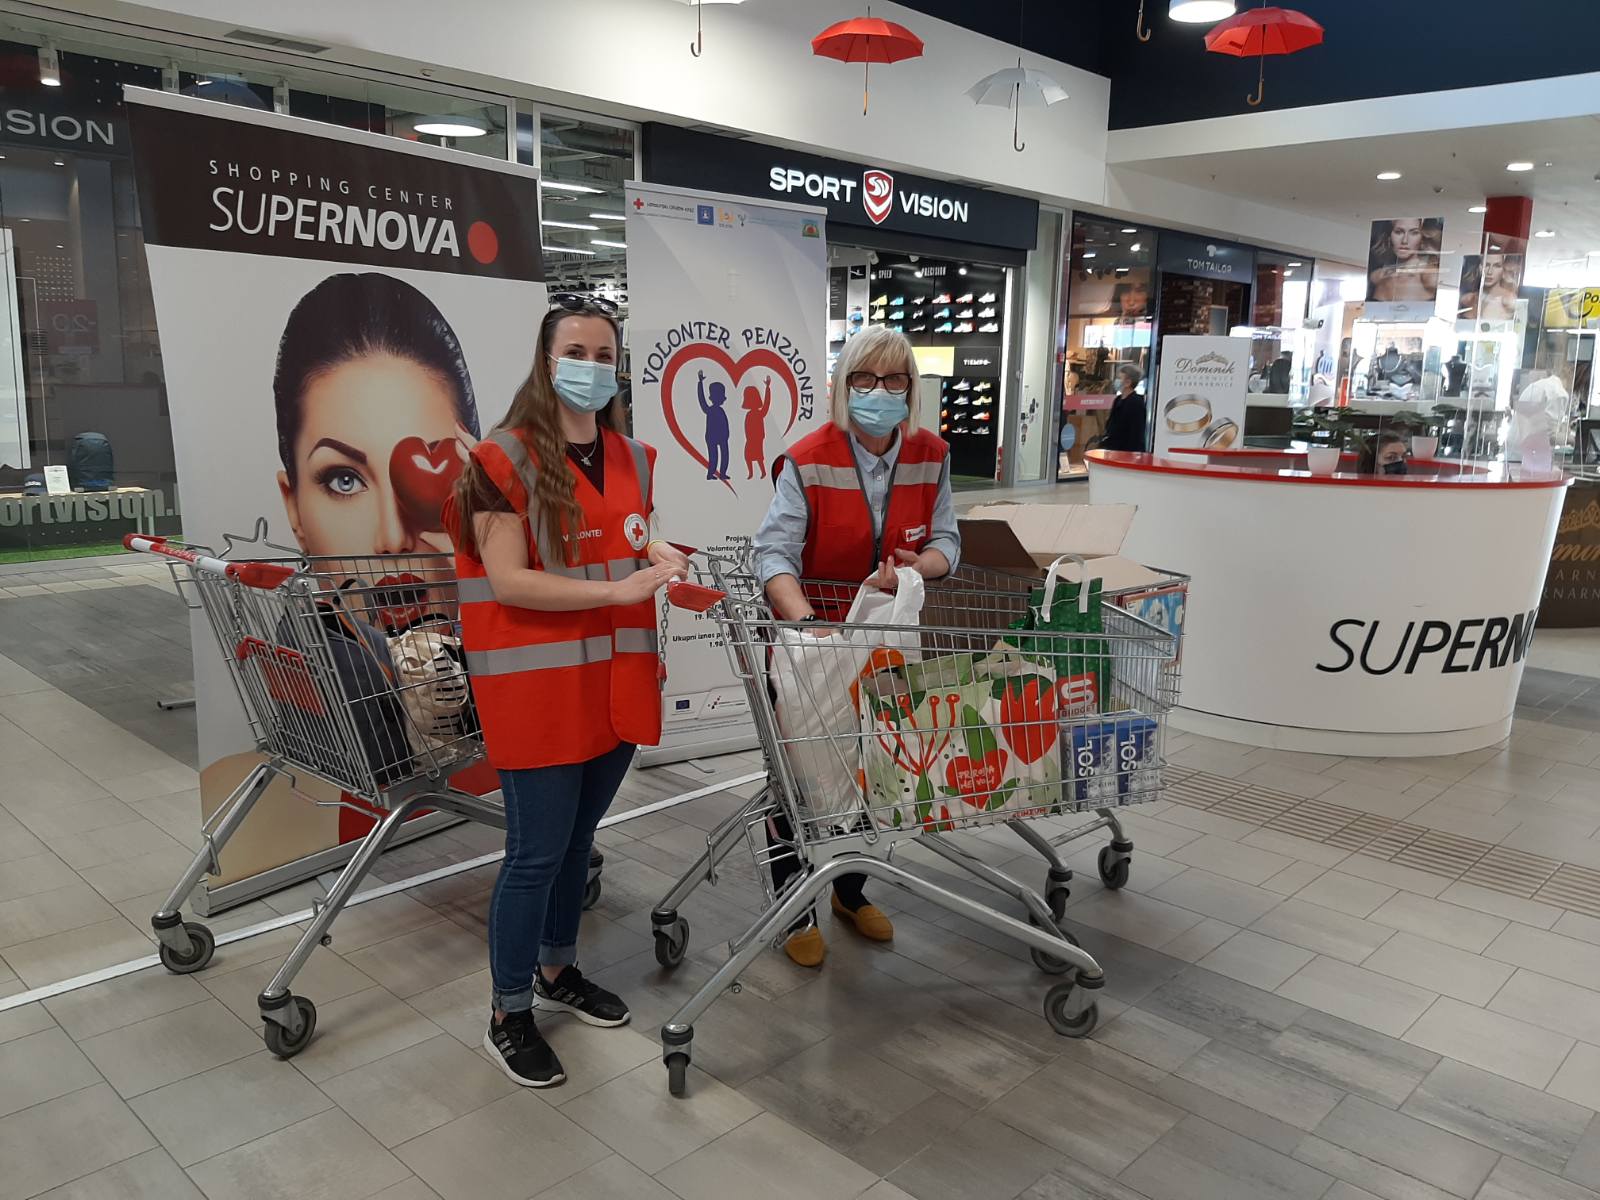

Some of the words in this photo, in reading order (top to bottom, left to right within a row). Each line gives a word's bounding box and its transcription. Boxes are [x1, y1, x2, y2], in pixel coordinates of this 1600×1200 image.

[0, 109, 114, 145] SION
[209, 159, 350, 194] SHOPPING
[368, 185, 454, 210] CENTER
[769, 167, 857, 203] SPORT
[209, 186, 461, 257] SUPERNOVA
[899, 190, 969, 223] VISION
[878, 269, 892, 279] SPEED
[1581, 292, 1600, 304] Po
[642, 321, 730, 385] VOLONTER
[742, 327, 813, 421] PENZIONER
[563, 529, 603, 543] VLONTE
[672, 633, 696, 642] Ukupni
[1078, 739, 1095, 777] SOL
[1120, 734, 1137, 771] SOL
